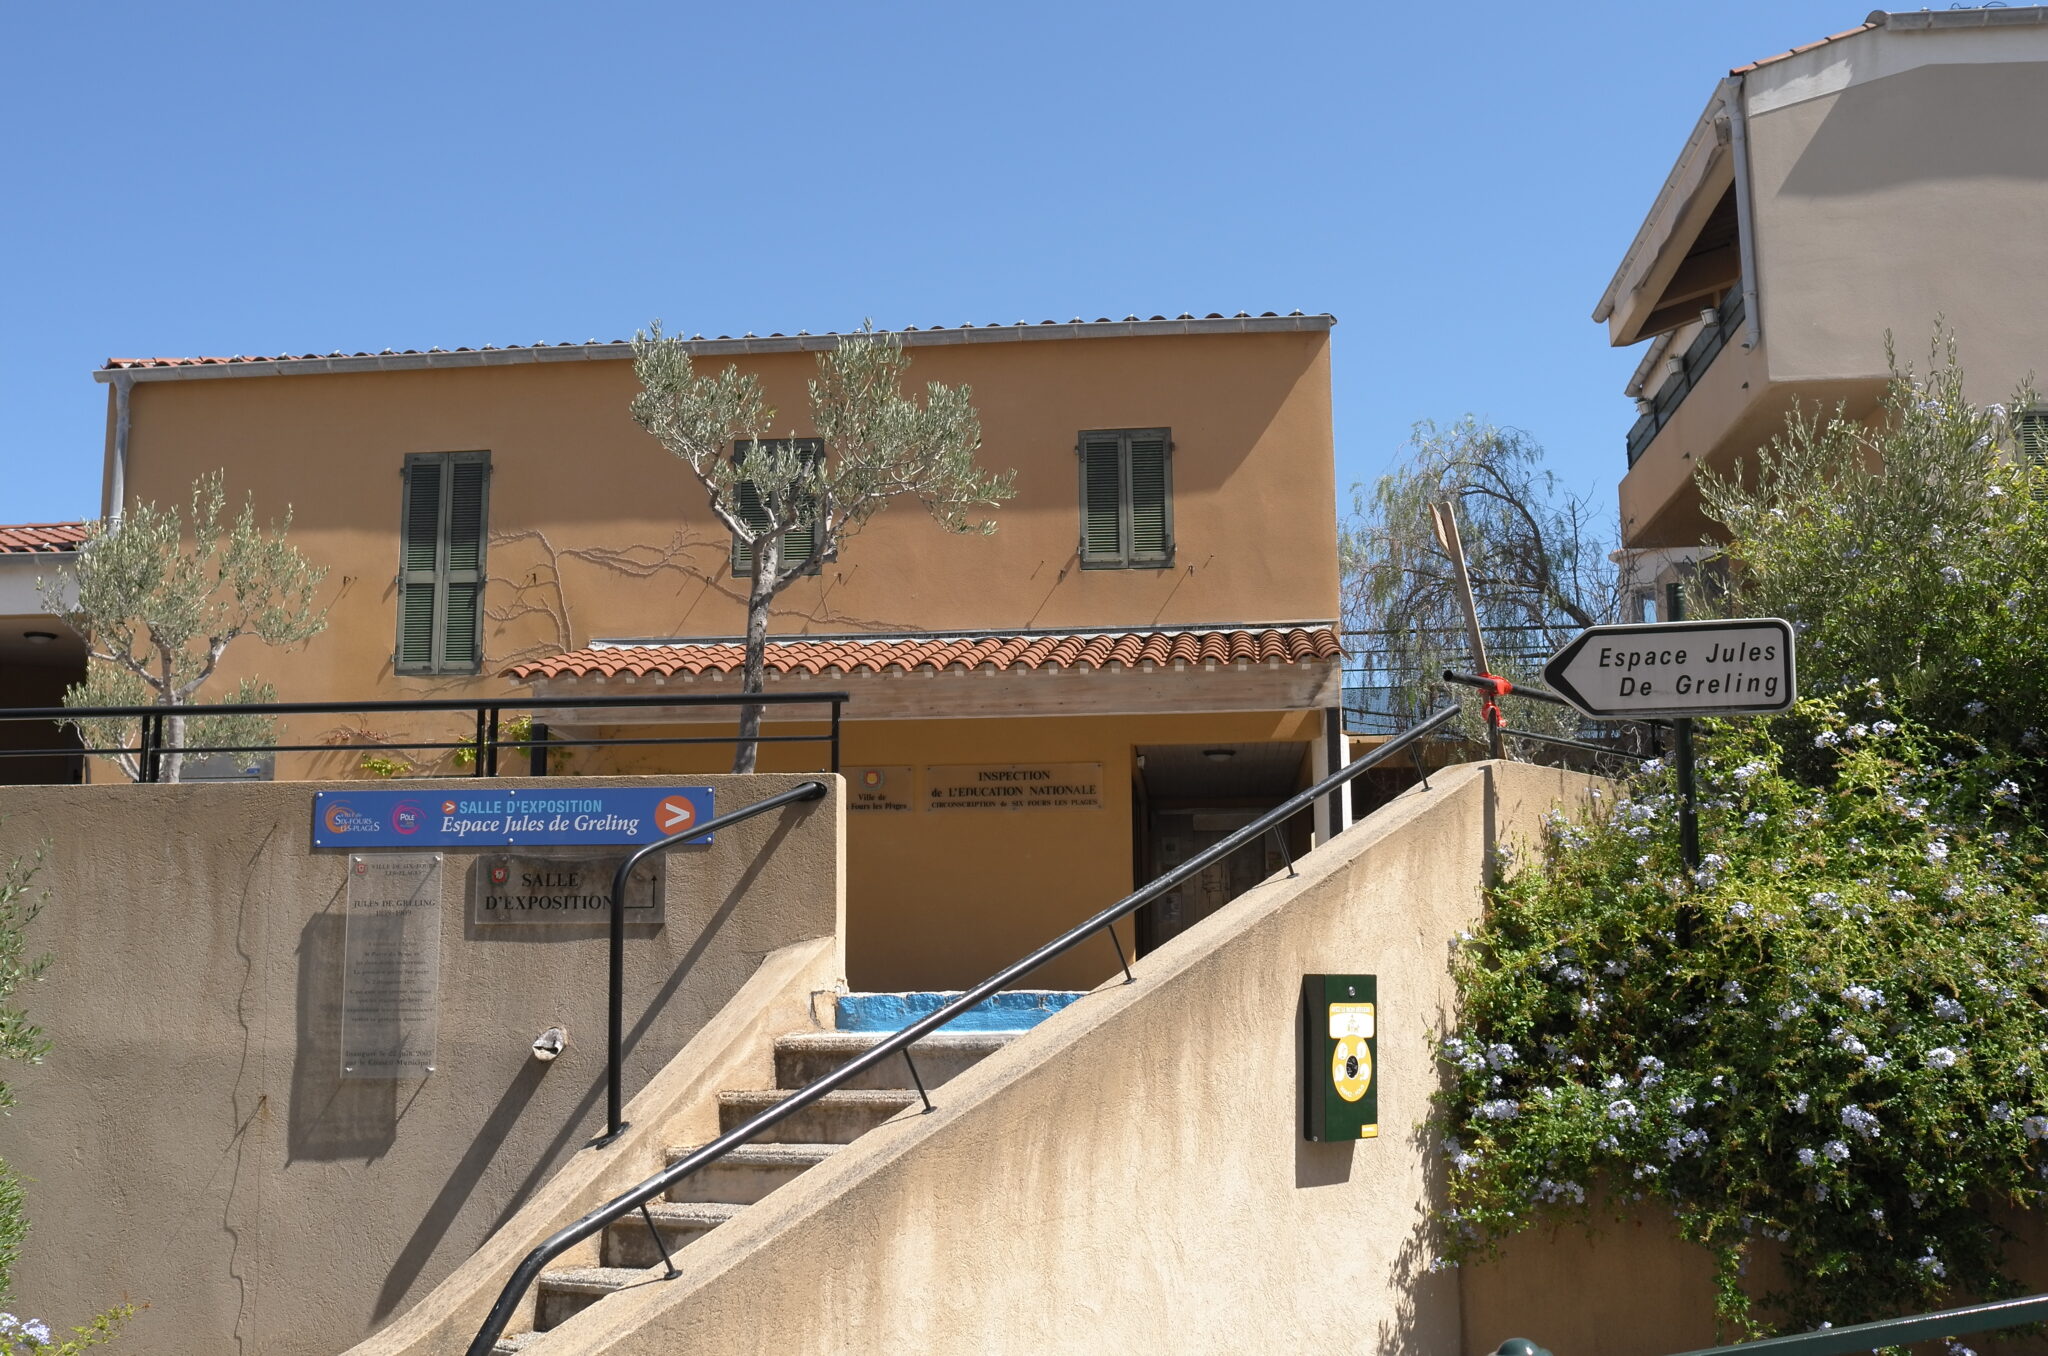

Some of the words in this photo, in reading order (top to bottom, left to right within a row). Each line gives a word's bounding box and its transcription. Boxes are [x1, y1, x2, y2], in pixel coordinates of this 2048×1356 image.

[1599, 647, 1687, 671] Espace
[1705, 641, 1776, 663] Jules
[1619, 677, 1652, 697] De
[1675, 672, 1778, 697] Greling
[978, 770, 1051, 782] INSPECTION
[858, 793, 876, 801] Ville
[931, 788, 943, 798] de
[948, 785, 1024, 798] L'EDUCATION
[1030, 784, 1097, 797] NATIONALE
[459, 801, 501, 814] SALLE
[507, 800, 602, 814] D'EXPOSITION
[851, 802, 870, 811] Fours
[872, 801, 883, 810] les
[884, 801, 907, 811] Plages
[931, 801, 996, 809] CIRCONSCRIPTION
[1071, 799, 1098, 807] PLAGES
[441, 816, 499, 836] Espace
[502, 814, 544, 834] Jules
[548, 813, 568, 831] de
[574, 814, 640, 835] Greling
[521, 872, 579, 888] SALLE
[354, 900, 379, 909] JULES
[382, 900, 394, 908] DE
[396, 899, 436, 908] GRELING
[486, 895, 613, 911] D'EXPOSITION
